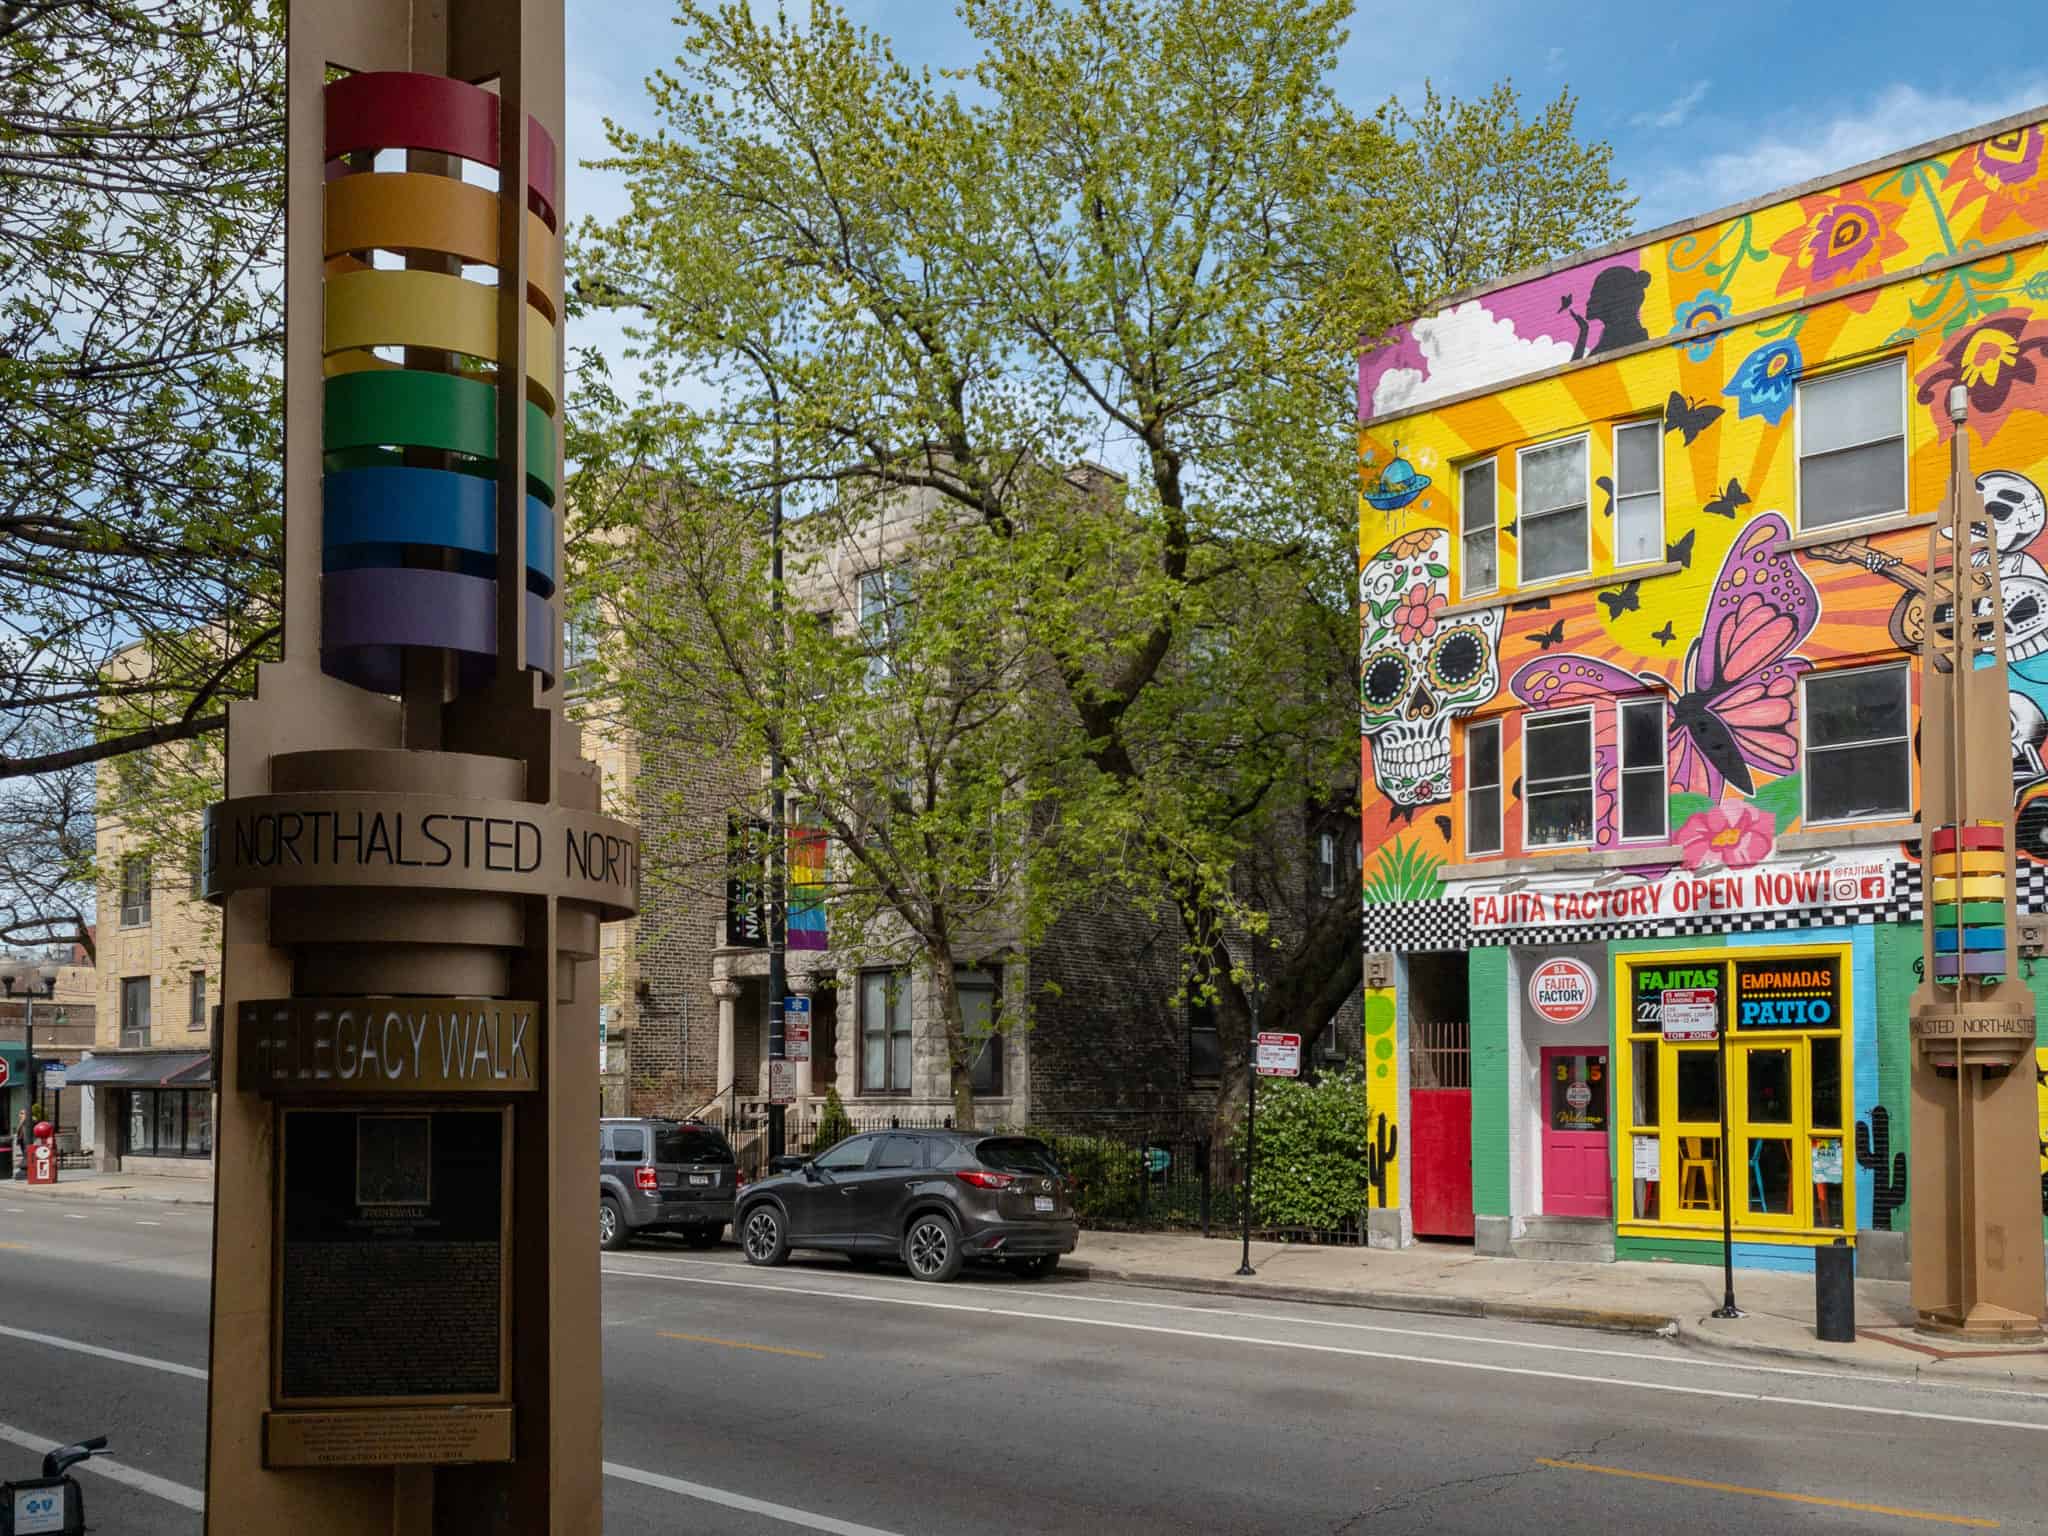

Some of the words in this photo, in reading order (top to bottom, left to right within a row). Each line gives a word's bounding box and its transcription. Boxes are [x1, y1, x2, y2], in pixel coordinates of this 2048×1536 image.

[235, 810, 542, 873] NORTHALSTED
[1472, 891, 1547, 926] FAJITA
[1553, 882, 1665, 921] FACTORY
[1672, 875, 1744, 912] OPEN
[1754, 869, 1831, 907] NOW!
[1544, 978, 1577, 990] FAJITA
[1640, 969, 1719, 990] FAJITAS
[1742, 970, 1832, 989] EMPANADAS
[1538, 989, 1585, 1002] FACTORY
[1741, 999, 1831, 1025] PATIO
[438, 1011, 531, 1081] WALK
